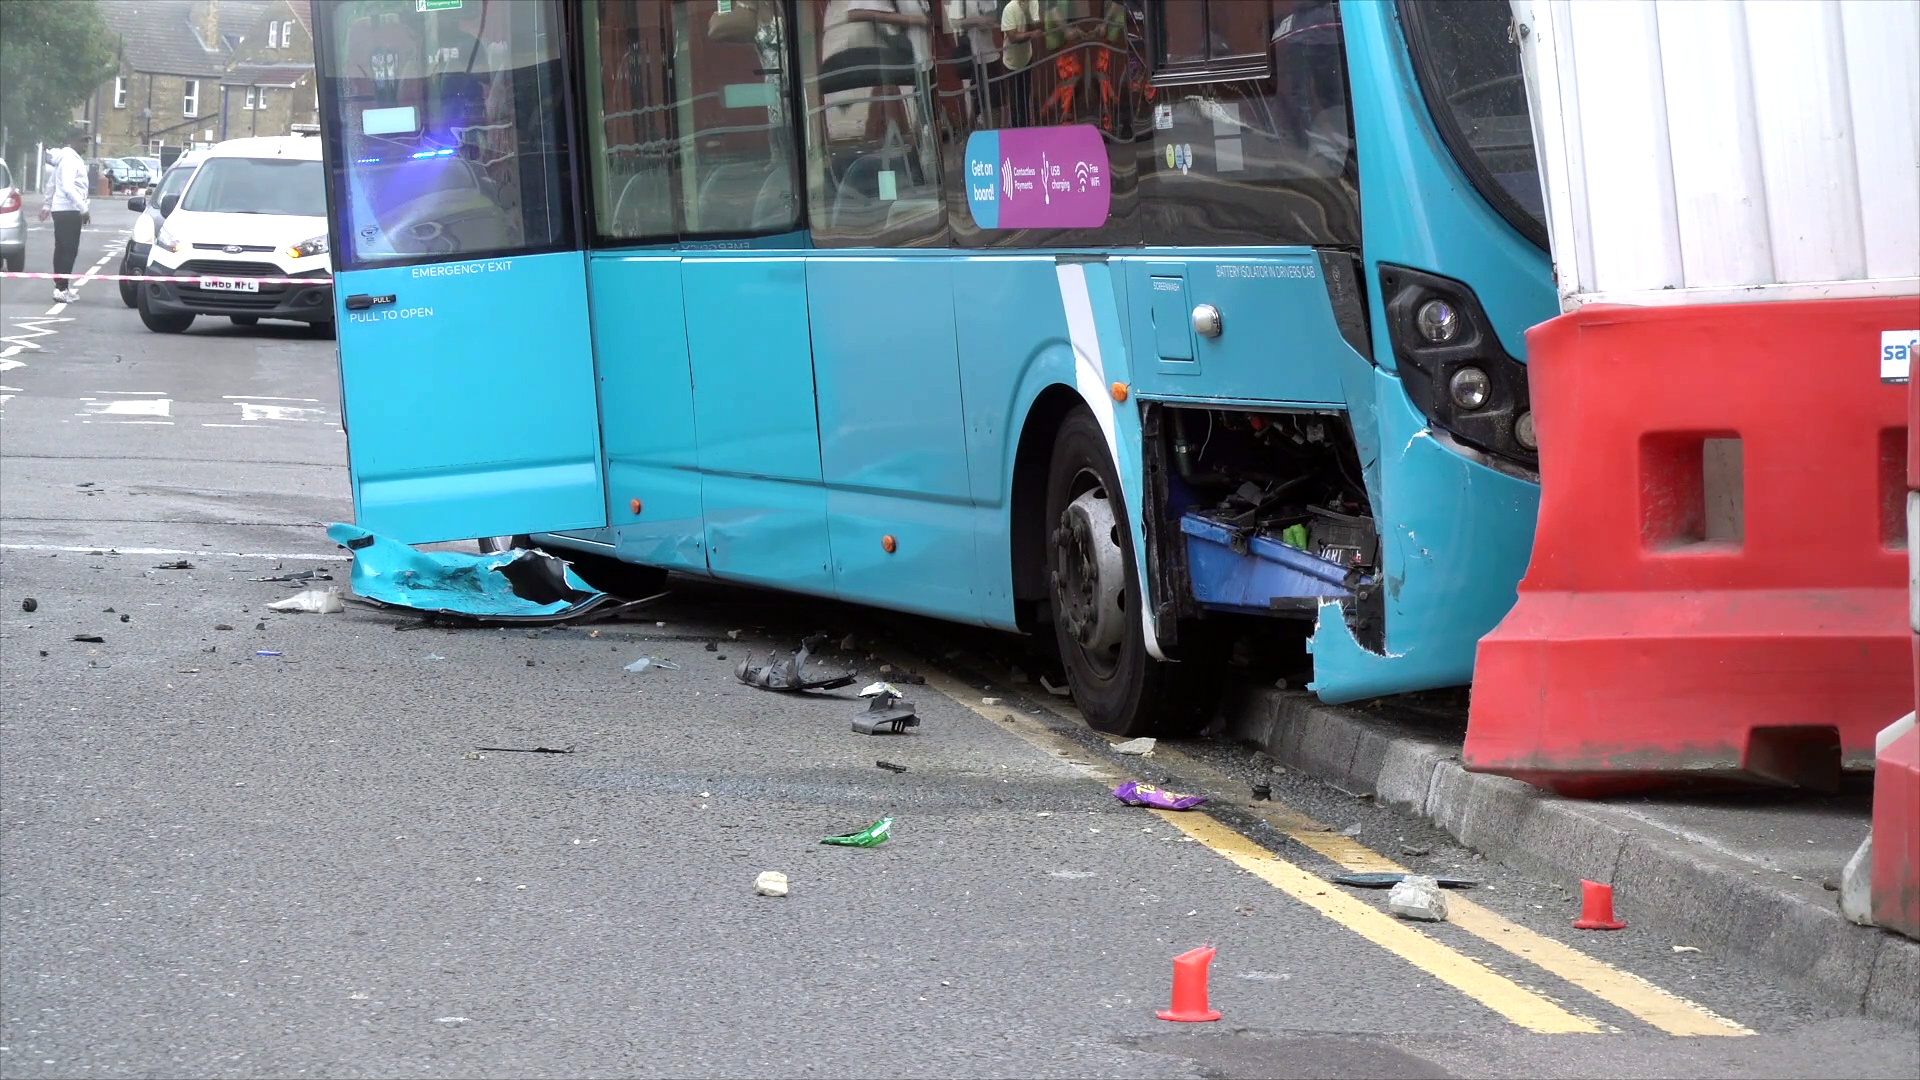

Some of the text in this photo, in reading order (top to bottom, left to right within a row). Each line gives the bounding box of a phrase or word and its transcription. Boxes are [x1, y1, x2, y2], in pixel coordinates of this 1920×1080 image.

[971, 160, 993, 176] Get on
[1013, 167, 1036, 176] Contactless
[1050, 165, 1061, 176] USB
[1089, 164, 1099, 174] Free
[1014, 181, 1034, 191] Payments
[1051, 179, 1071, 192] charging
[973, 184, 995, 201] board!
[412, 261, 513, 278] EMERGENCY EXIT
[1216, 265, 1316, 279] BATTERY ISOLATOR IN DRIVERS CAB
[1153, 281, 1181, 291] SCREENWASH
[373, 296, 391, 304] PULL
[350, 307, 434, 323] PULL TO OPEN
